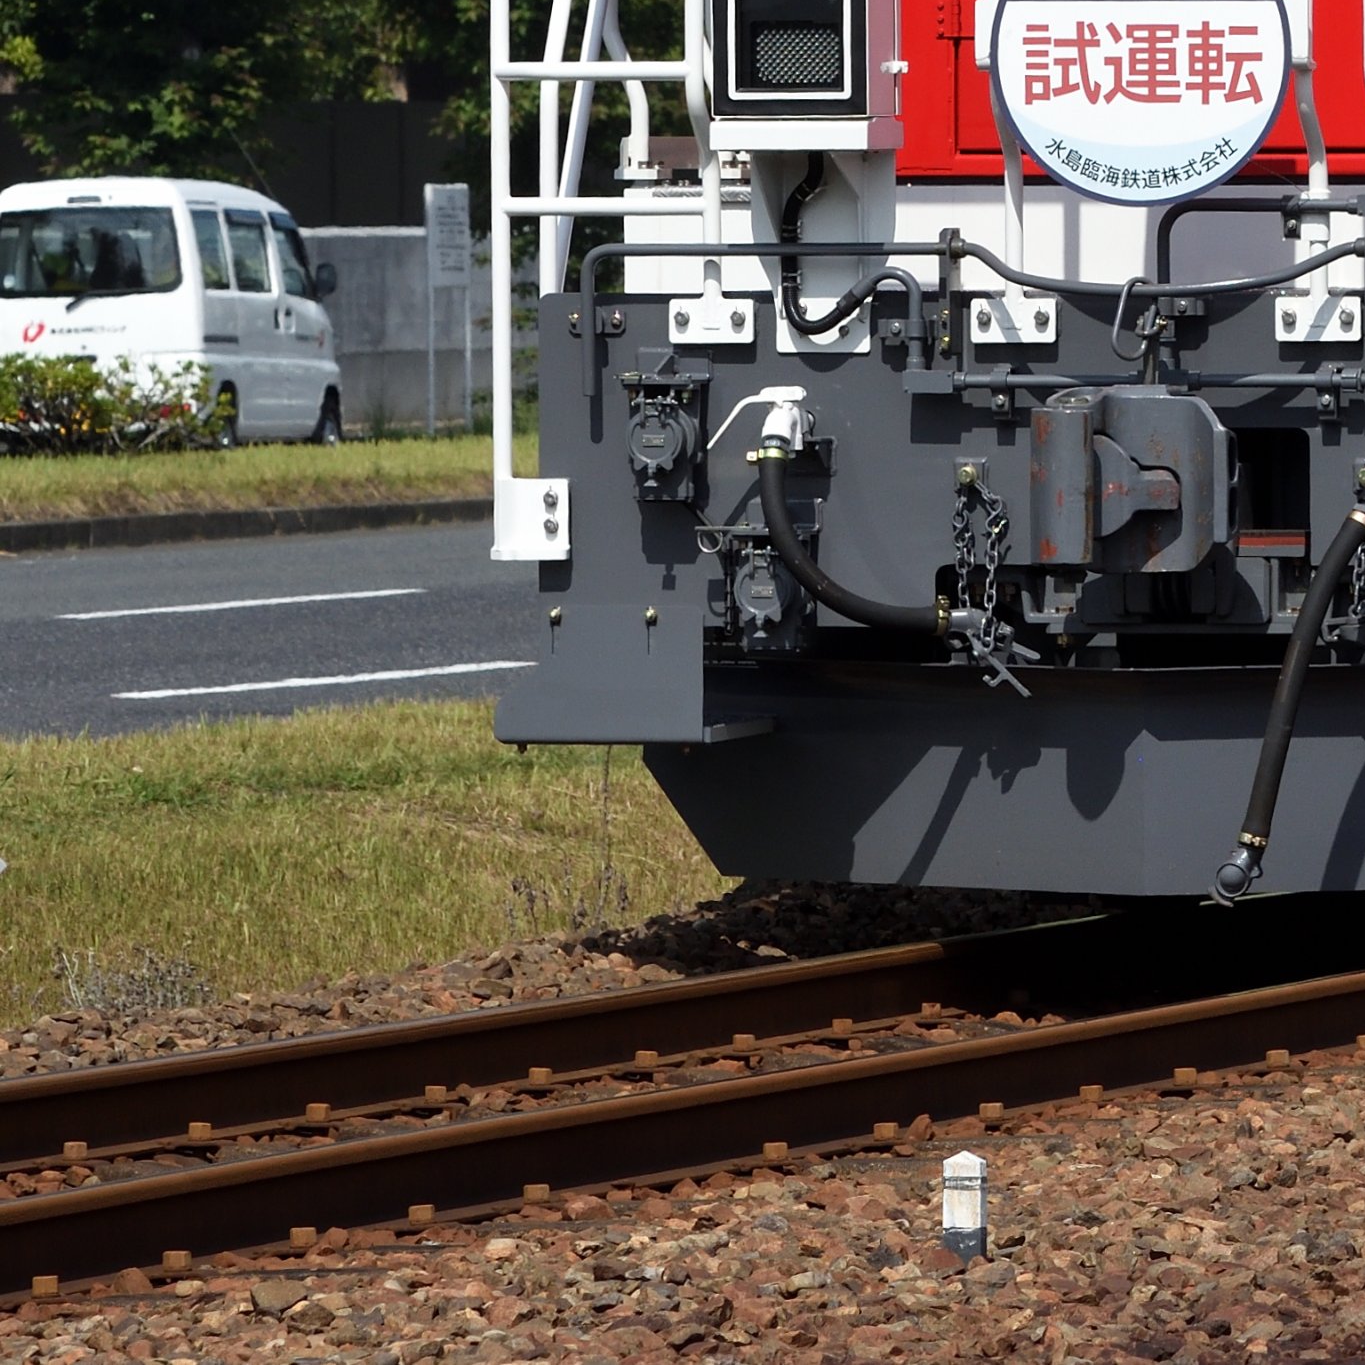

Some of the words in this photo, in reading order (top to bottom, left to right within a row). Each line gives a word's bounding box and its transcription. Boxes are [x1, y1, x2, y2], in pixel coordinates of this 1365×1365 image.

[1022, 20, 1263, 106] 試運転
[1044, 136, 1239, 190] 水島臨海鉄道株式会社
